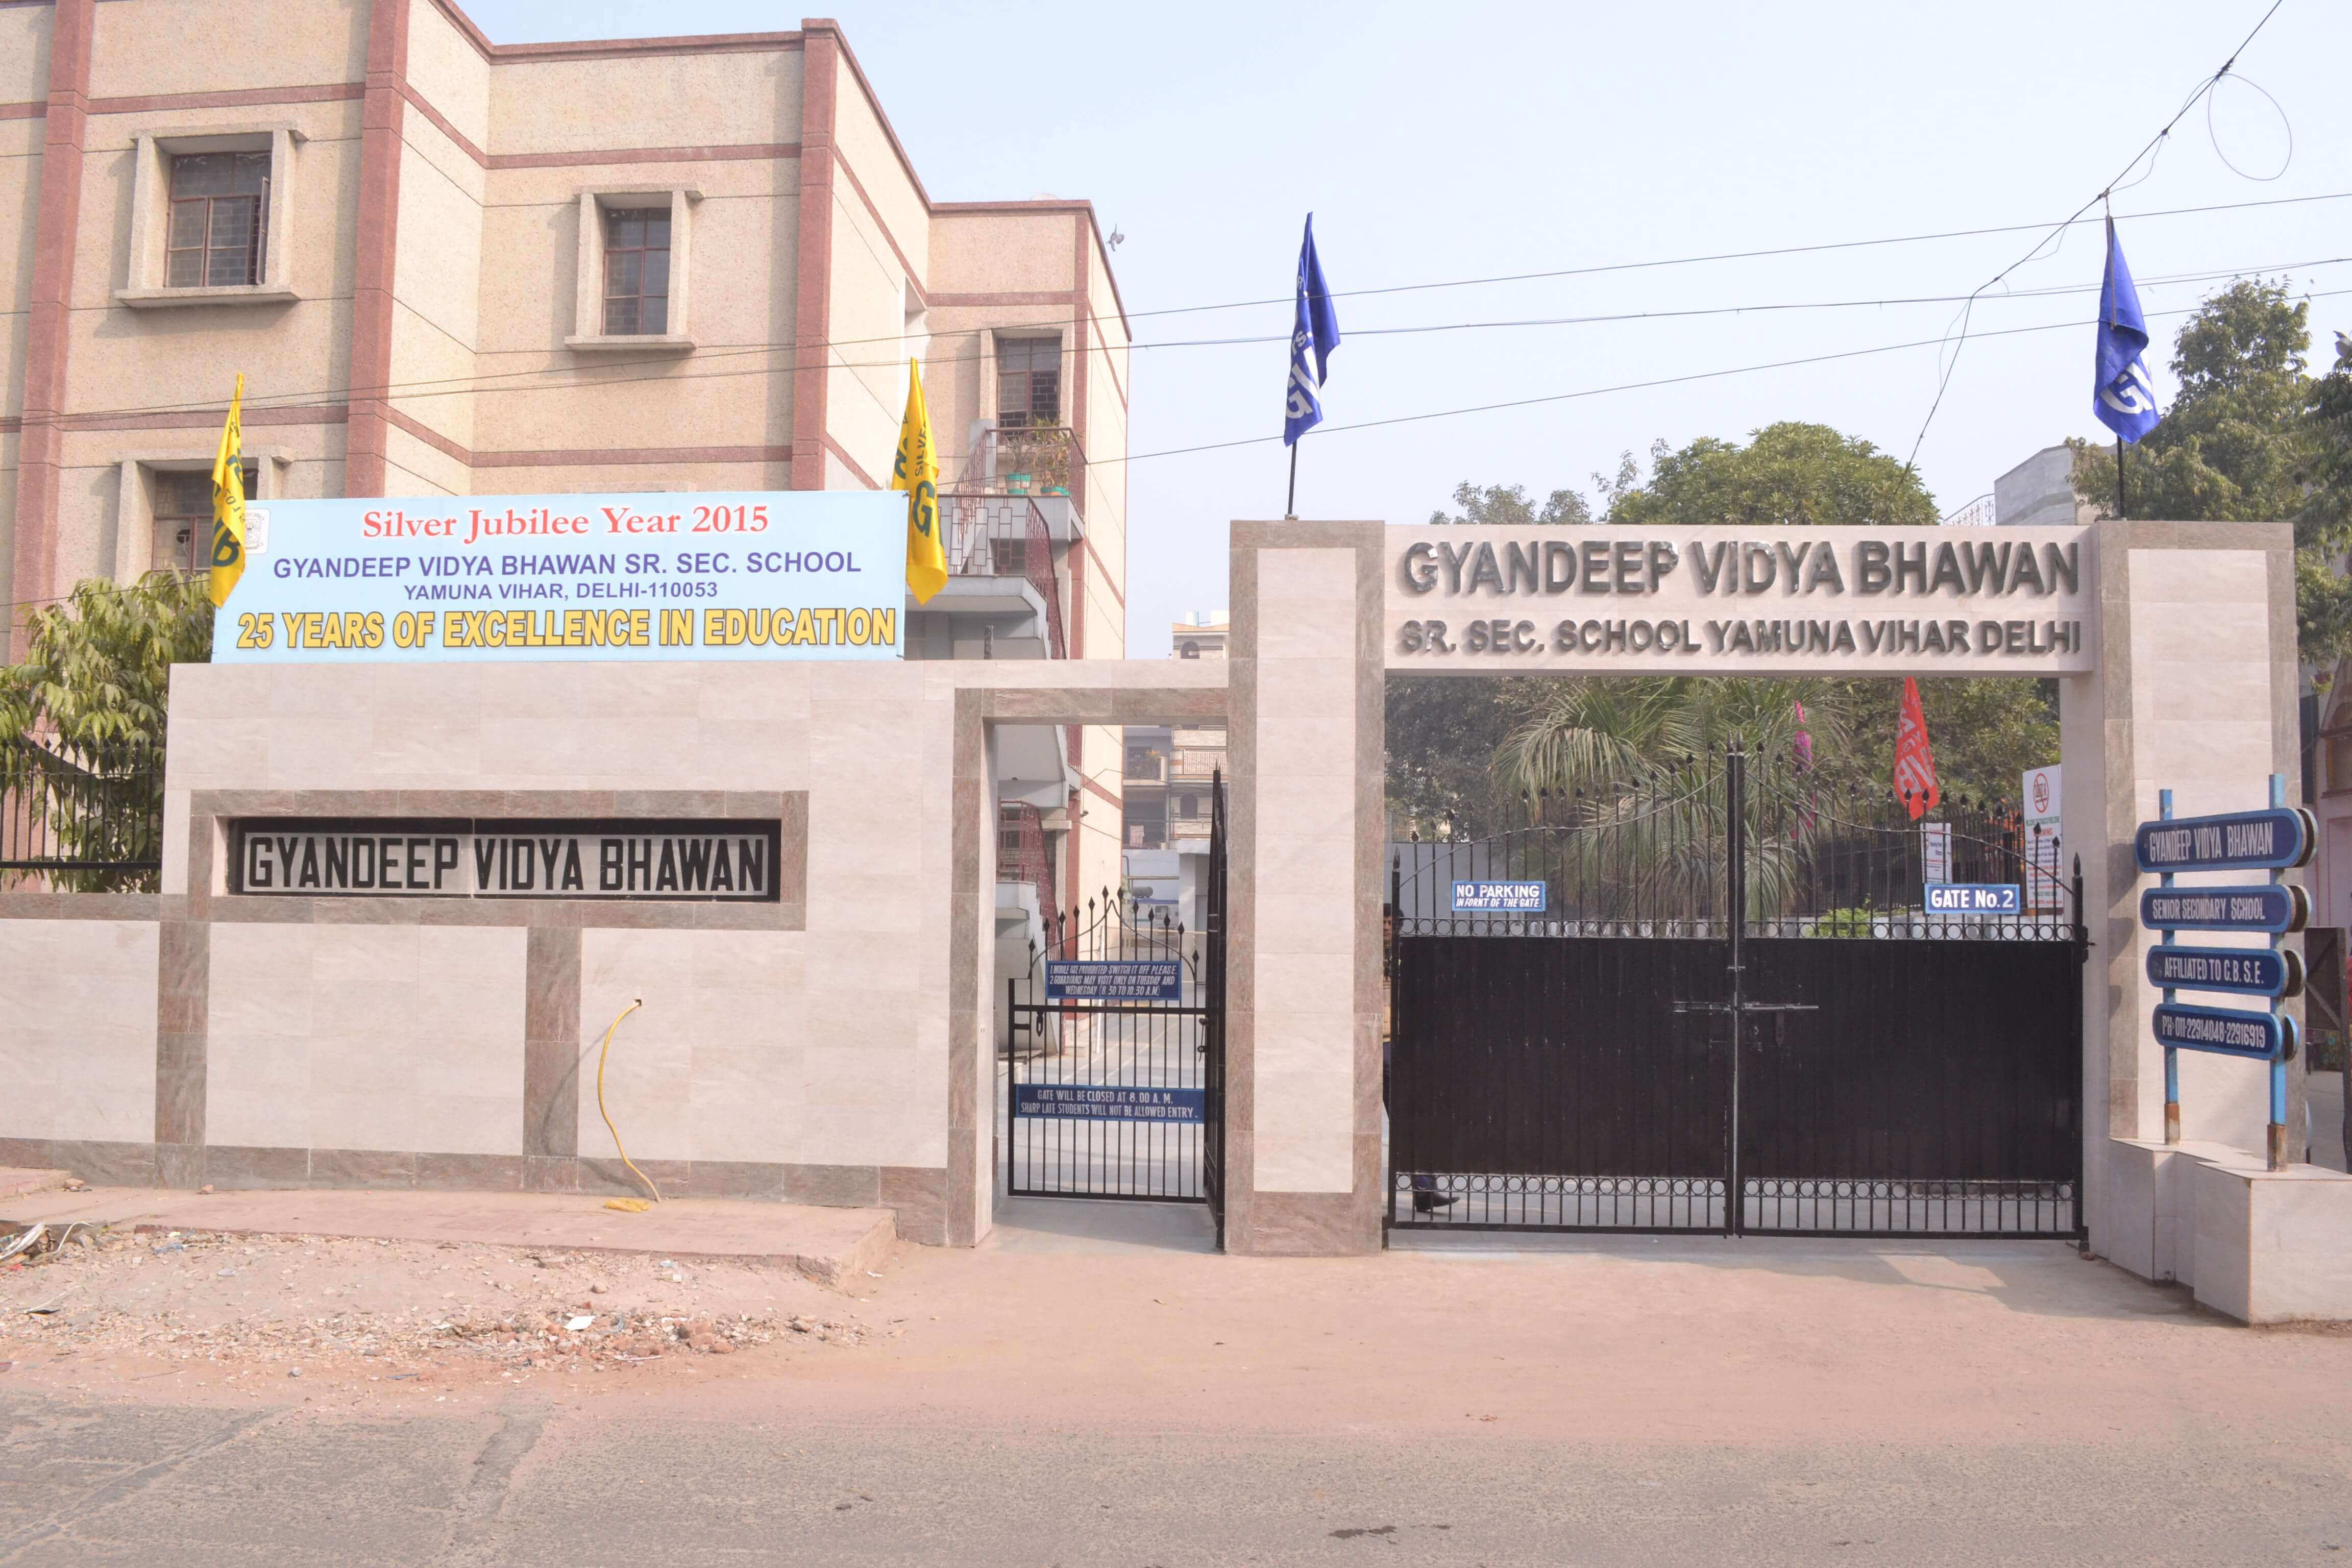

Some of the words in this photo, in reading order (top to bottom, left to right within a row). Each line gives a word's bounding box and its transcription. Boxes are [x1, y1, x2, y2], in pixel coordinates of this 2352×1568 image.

[363, 511, 457, 537] Silver
[463, 508, 589, 544] Jubilee
[601, 507, 681, 533] Year
[691, 505, 769, 532] 2015
[273, 557, 411, 578] GYANDEEP
[418, 555, 494, 577] VIDYA
[501, 554, 615, 576] BHAWAN
[624, 553, 667, 574] SR.
[676, 552, 737, 574] SEC.
[746, 551, 862, 573] SCHOOL
[1403, 541, 1679, 593] GYANDEEP
[1690, 541, 1845, 593] VIDYA
[1857, 541, 2078, 594] BHAWAN
[403, 583, 493, 600] YAMUNA
[498, 583, 569, 601] VIHAR,
[576, 581, 718, 598] DELHI-110053
[236, 611, 275, 649] 25
[282, 611, 384, 649] YEARS
[392, 610, 435, 648] OF
[443, 609, 650, 648] EXCELLENCE
[658, 608, 694, 646] IN
[703, 607, 896, 646] EDUCATION
[1402, 620, 1457, 652] SR.
[1469, 620, 1545, 652] SEC.
[1556, 619, 1702, 652] SCHOOL
[1708, 620, 1857, 652] YAMUNA
[1861, 620, 1972, 653] VIHAR
[1980, 620, 2080, 653] DELHI
[2149, 829, 2191, 863] GYANDEEP
[2194, 826, 2222, 860] VIDYA
[2226, 822, 2273, 857] BHAWAN
[249, 837, 459, 890] GYANDEEP
[474, 838, 584, 891] VIDYA
[600, 839, 764, 892] BHAWAN
[1456, 884, 1475, 897] NO
[1479, 885, 1540, 898] PARKING
[1930, 889, 1970, 908] GATE
[1456, 898, 1464, 907] IN
[1464, 898, 1489, 907] FORNT
[1490, 898, 1501, 907] OF
[1503, 898, 1518, 908] THE
[2152, 899, 2180, 919] SENIOR
[2182, 898, 2226, 920] SECONDARY
[2231, 897, 2266, 920] SCHOOL
[1108, 965, 1132, 975] SWITCH
[1131, 965, 1139, 975] IT
[1138, 965, 1150, 975] OFF
[2164, 957, 2208, 981] AFFILIATED
[2209, 959, 2221, 981] TO
[1065, 985, 1098, 995] WEDNESDAY
[1118, 985, 1126, 996] TO
[1083, 975, 1097, 985] MAY
[1097, 975, 1114, 986] VISIT
[1113, 975, 1128, 986] ONLY
[1128, 975, 1137, 986] ON
[1136, 975, 1161, 986] TUESDAY
[1162, 975, 1175, 986] AND
[1037, 1090, 1054, 1100] GATE
[1056, 1090, 1074, 1101] WILL
[1076, 1090, 1086, 1101] BE
[1087, 1091, 1114, 1102] CLOSED
[1117, 1091, 1127, 1102] AT
[1020, 1102, 1041, 1113] SHARP
[1042, 1103, 1056, 1114] LATE
[1058, 1103, 1090, 1115] STUDENTS
[1091, 1104, 1107, 1115] WILL
[1109, 1105, 1122, 1116] NOT
[1124, 1105, 1132, 1116] BE
[1134, 1106, 1166, 1117] ALLOWED
